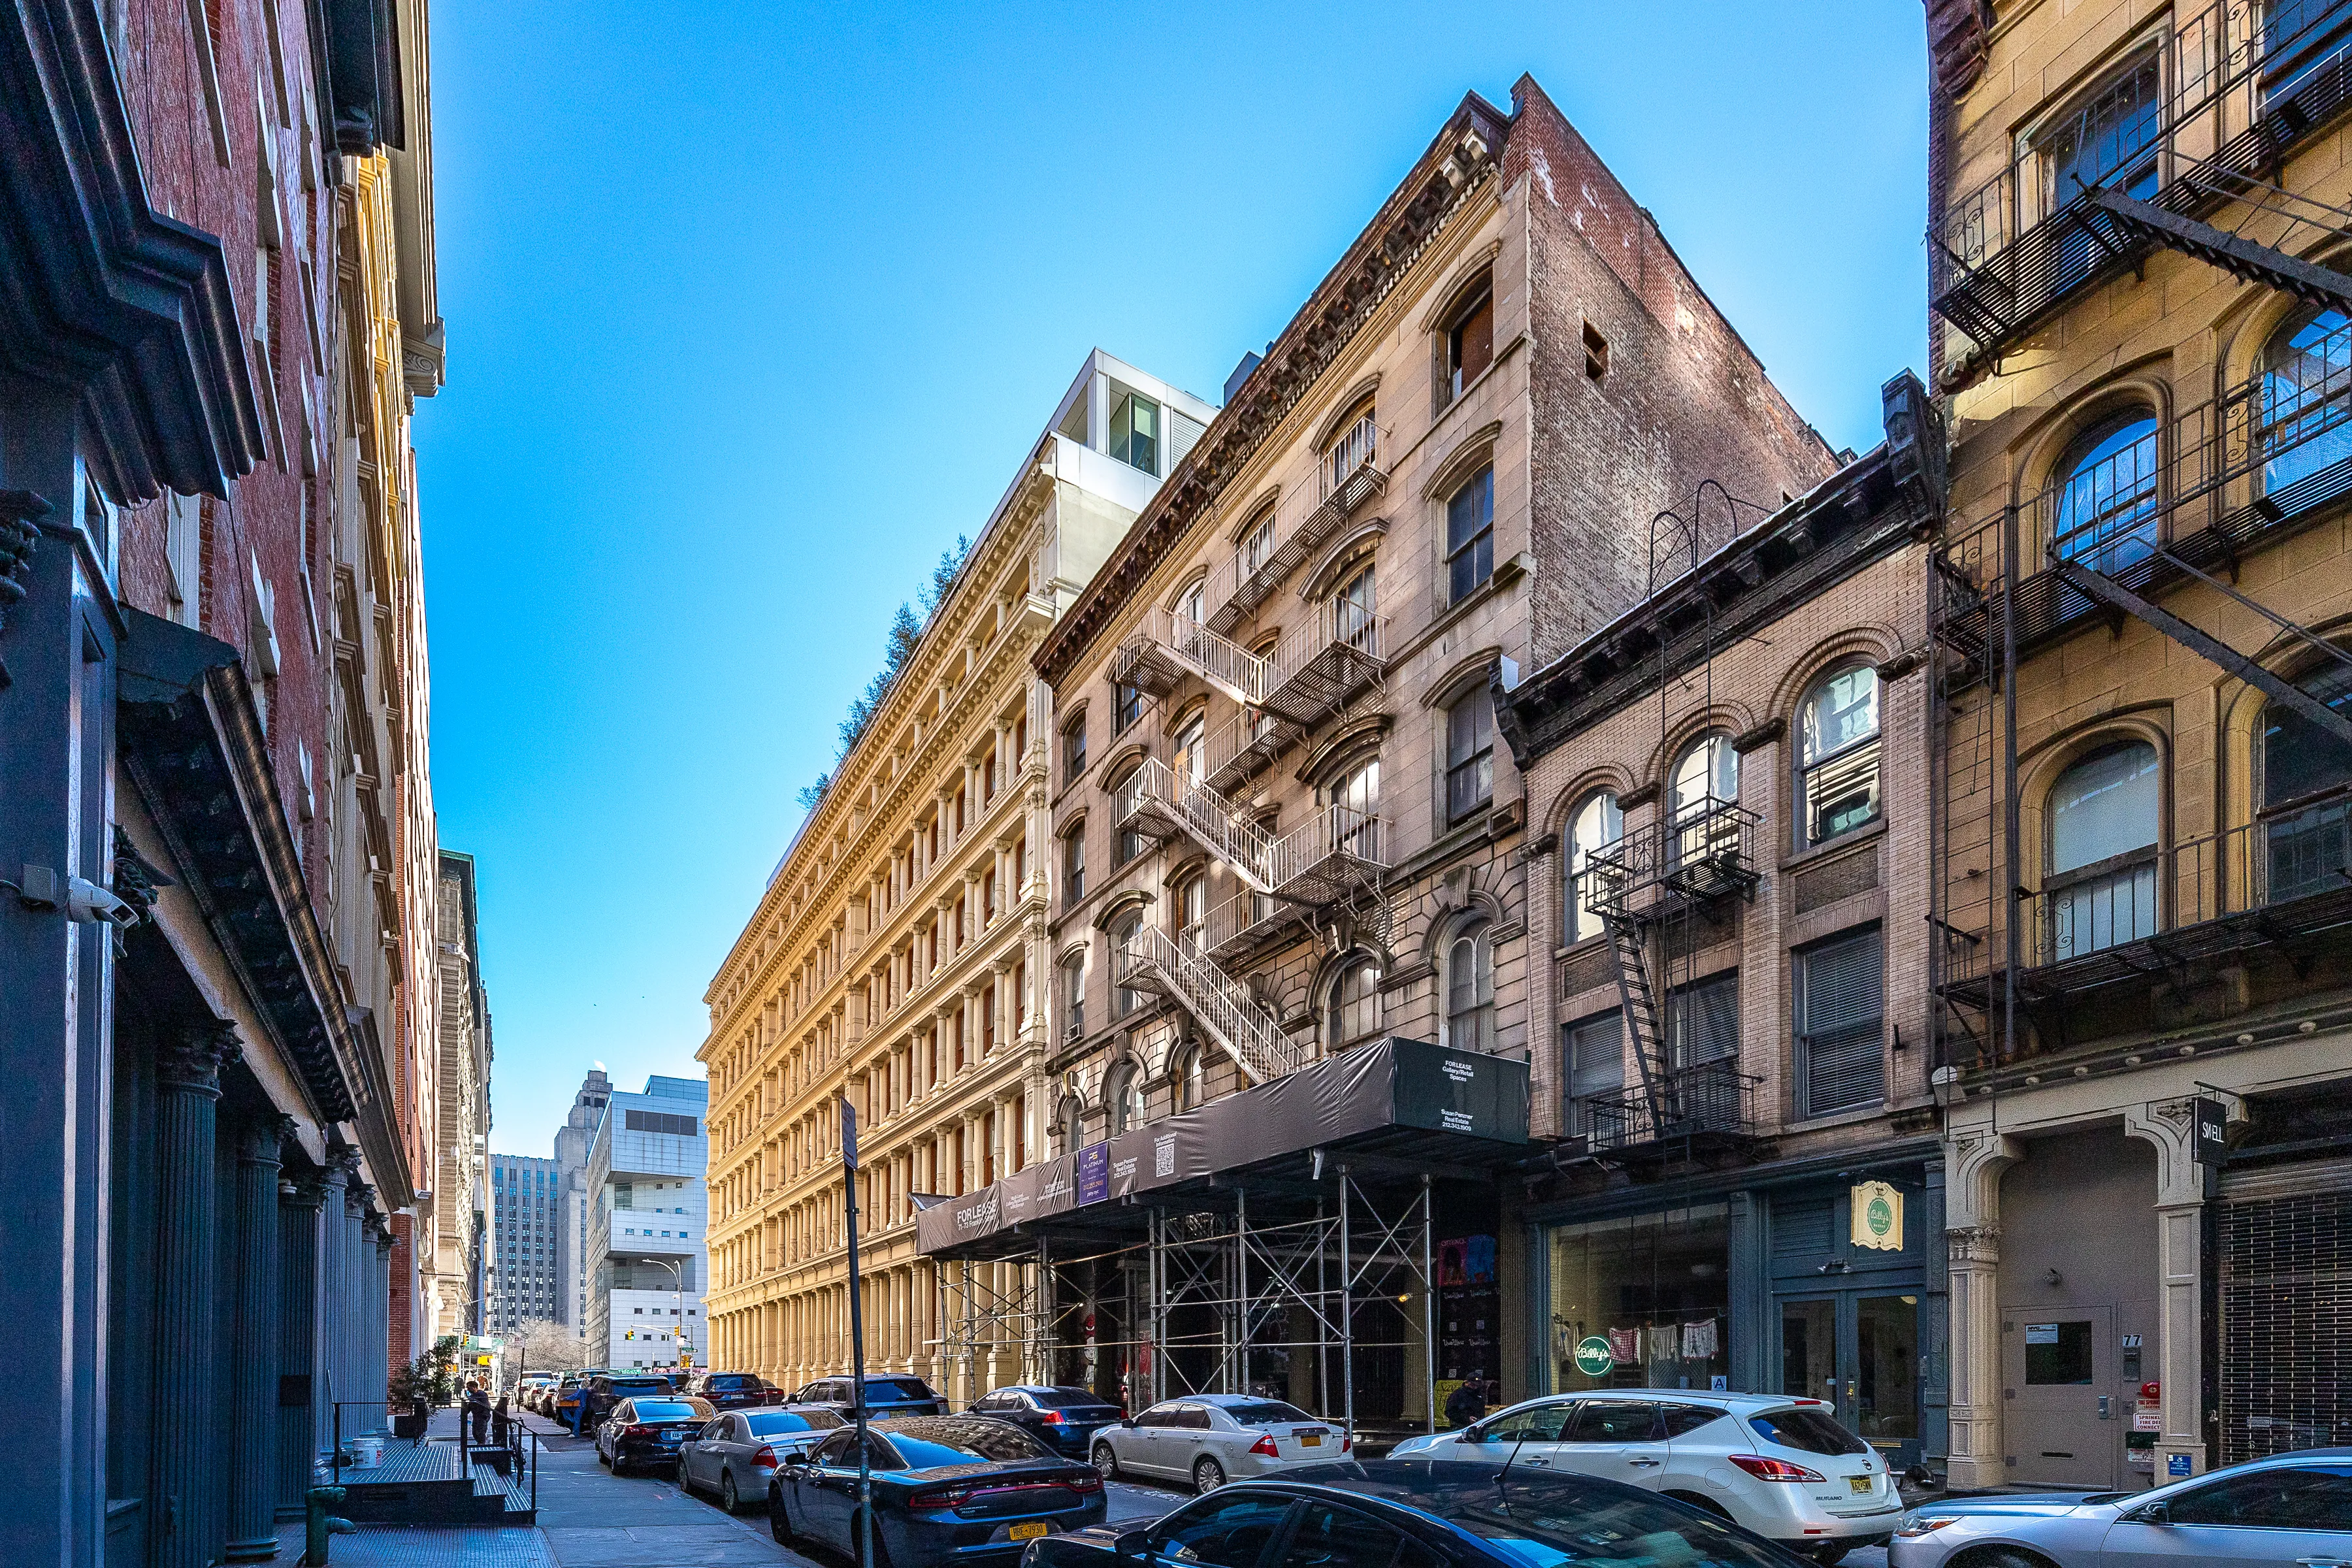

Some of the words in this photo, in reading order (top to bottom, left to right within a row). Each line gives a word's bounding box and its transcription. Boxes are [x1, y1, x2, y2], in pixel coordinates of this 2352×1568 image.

[1442, 1066, 1474, 1077] Gallery/Retail
[1456, 1062, 1473, 1071] LEASE
[1449, 1073, 1467, 1082] Spaces
[1442, 1121, 1471, 1132] 212.343.1909
[1160, 1131, 1177, 1141] Additional
[1083, 1158, 1103, 1169] PLATINUM
[957, 1207, 972, 1224] FOR
[1870, 1209, 1889, 1224] Billy's
[958, 1221, 969, 1231] 71-73
[2123, 1334, 2141, 1346] 77
[1577, 1347, 1610, 1362] Billy's
[1714, 1377, 1725, 1389] A
